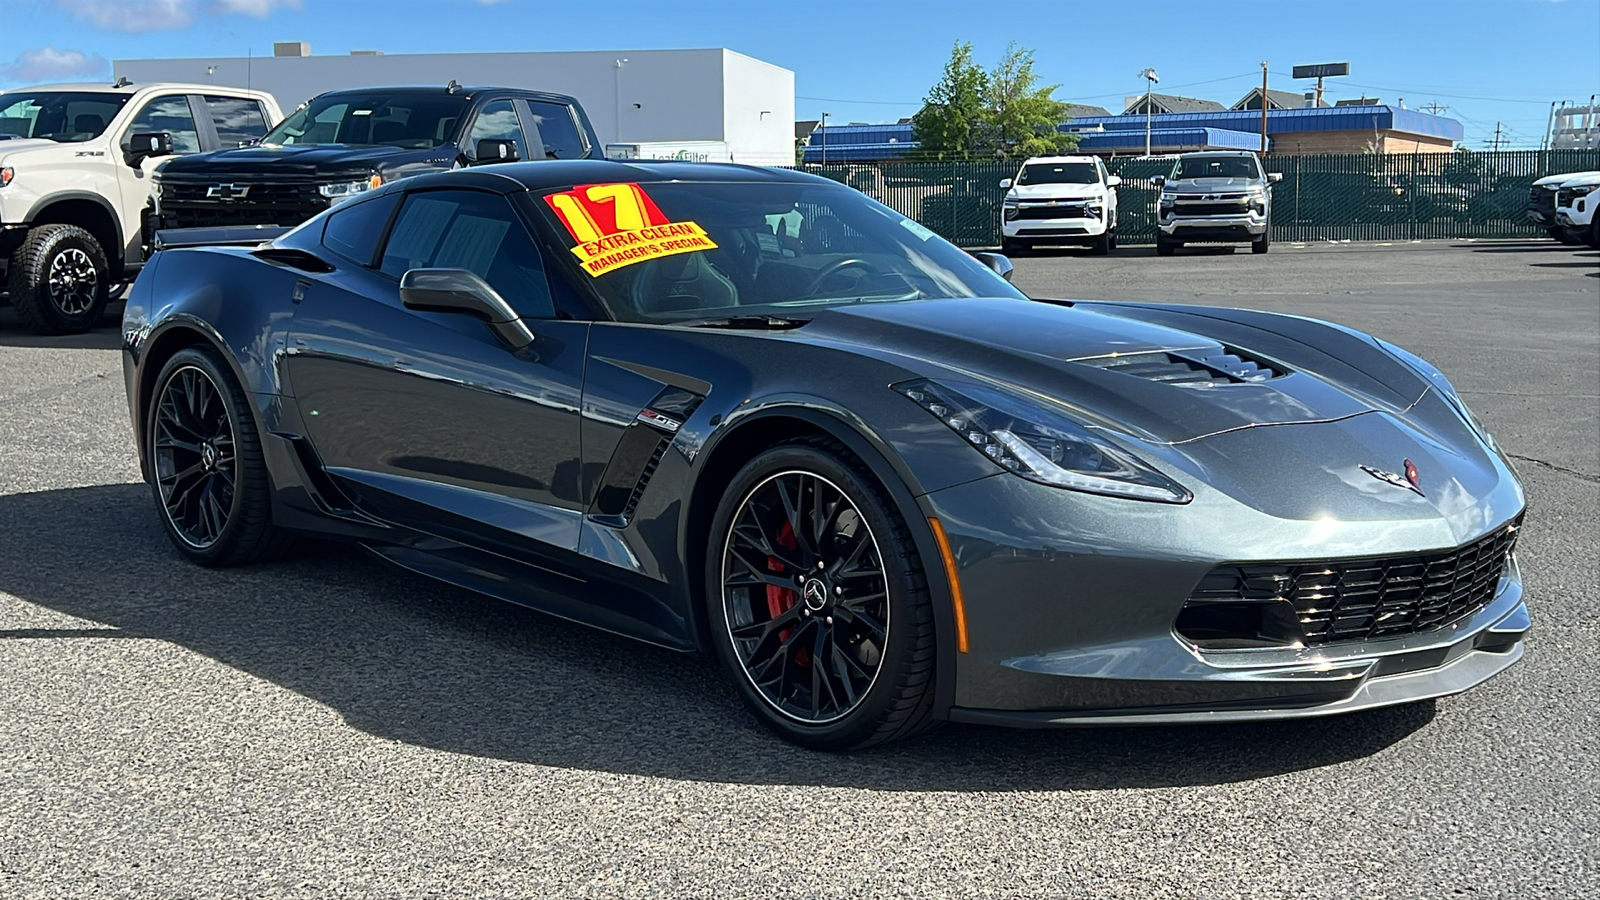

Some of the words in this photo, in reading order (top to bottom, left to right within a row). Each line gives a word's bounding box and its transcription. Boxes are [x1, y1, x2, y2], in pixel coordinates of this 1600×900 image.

[552, 185, 648, 243] 17
[582, 232, 641, 257] EXTRA
[640, 223, 695, 241] CLEAN
[587, 246, 660, 272] MANAGER'S
[659, 237, 709, 251] SPECIAL
